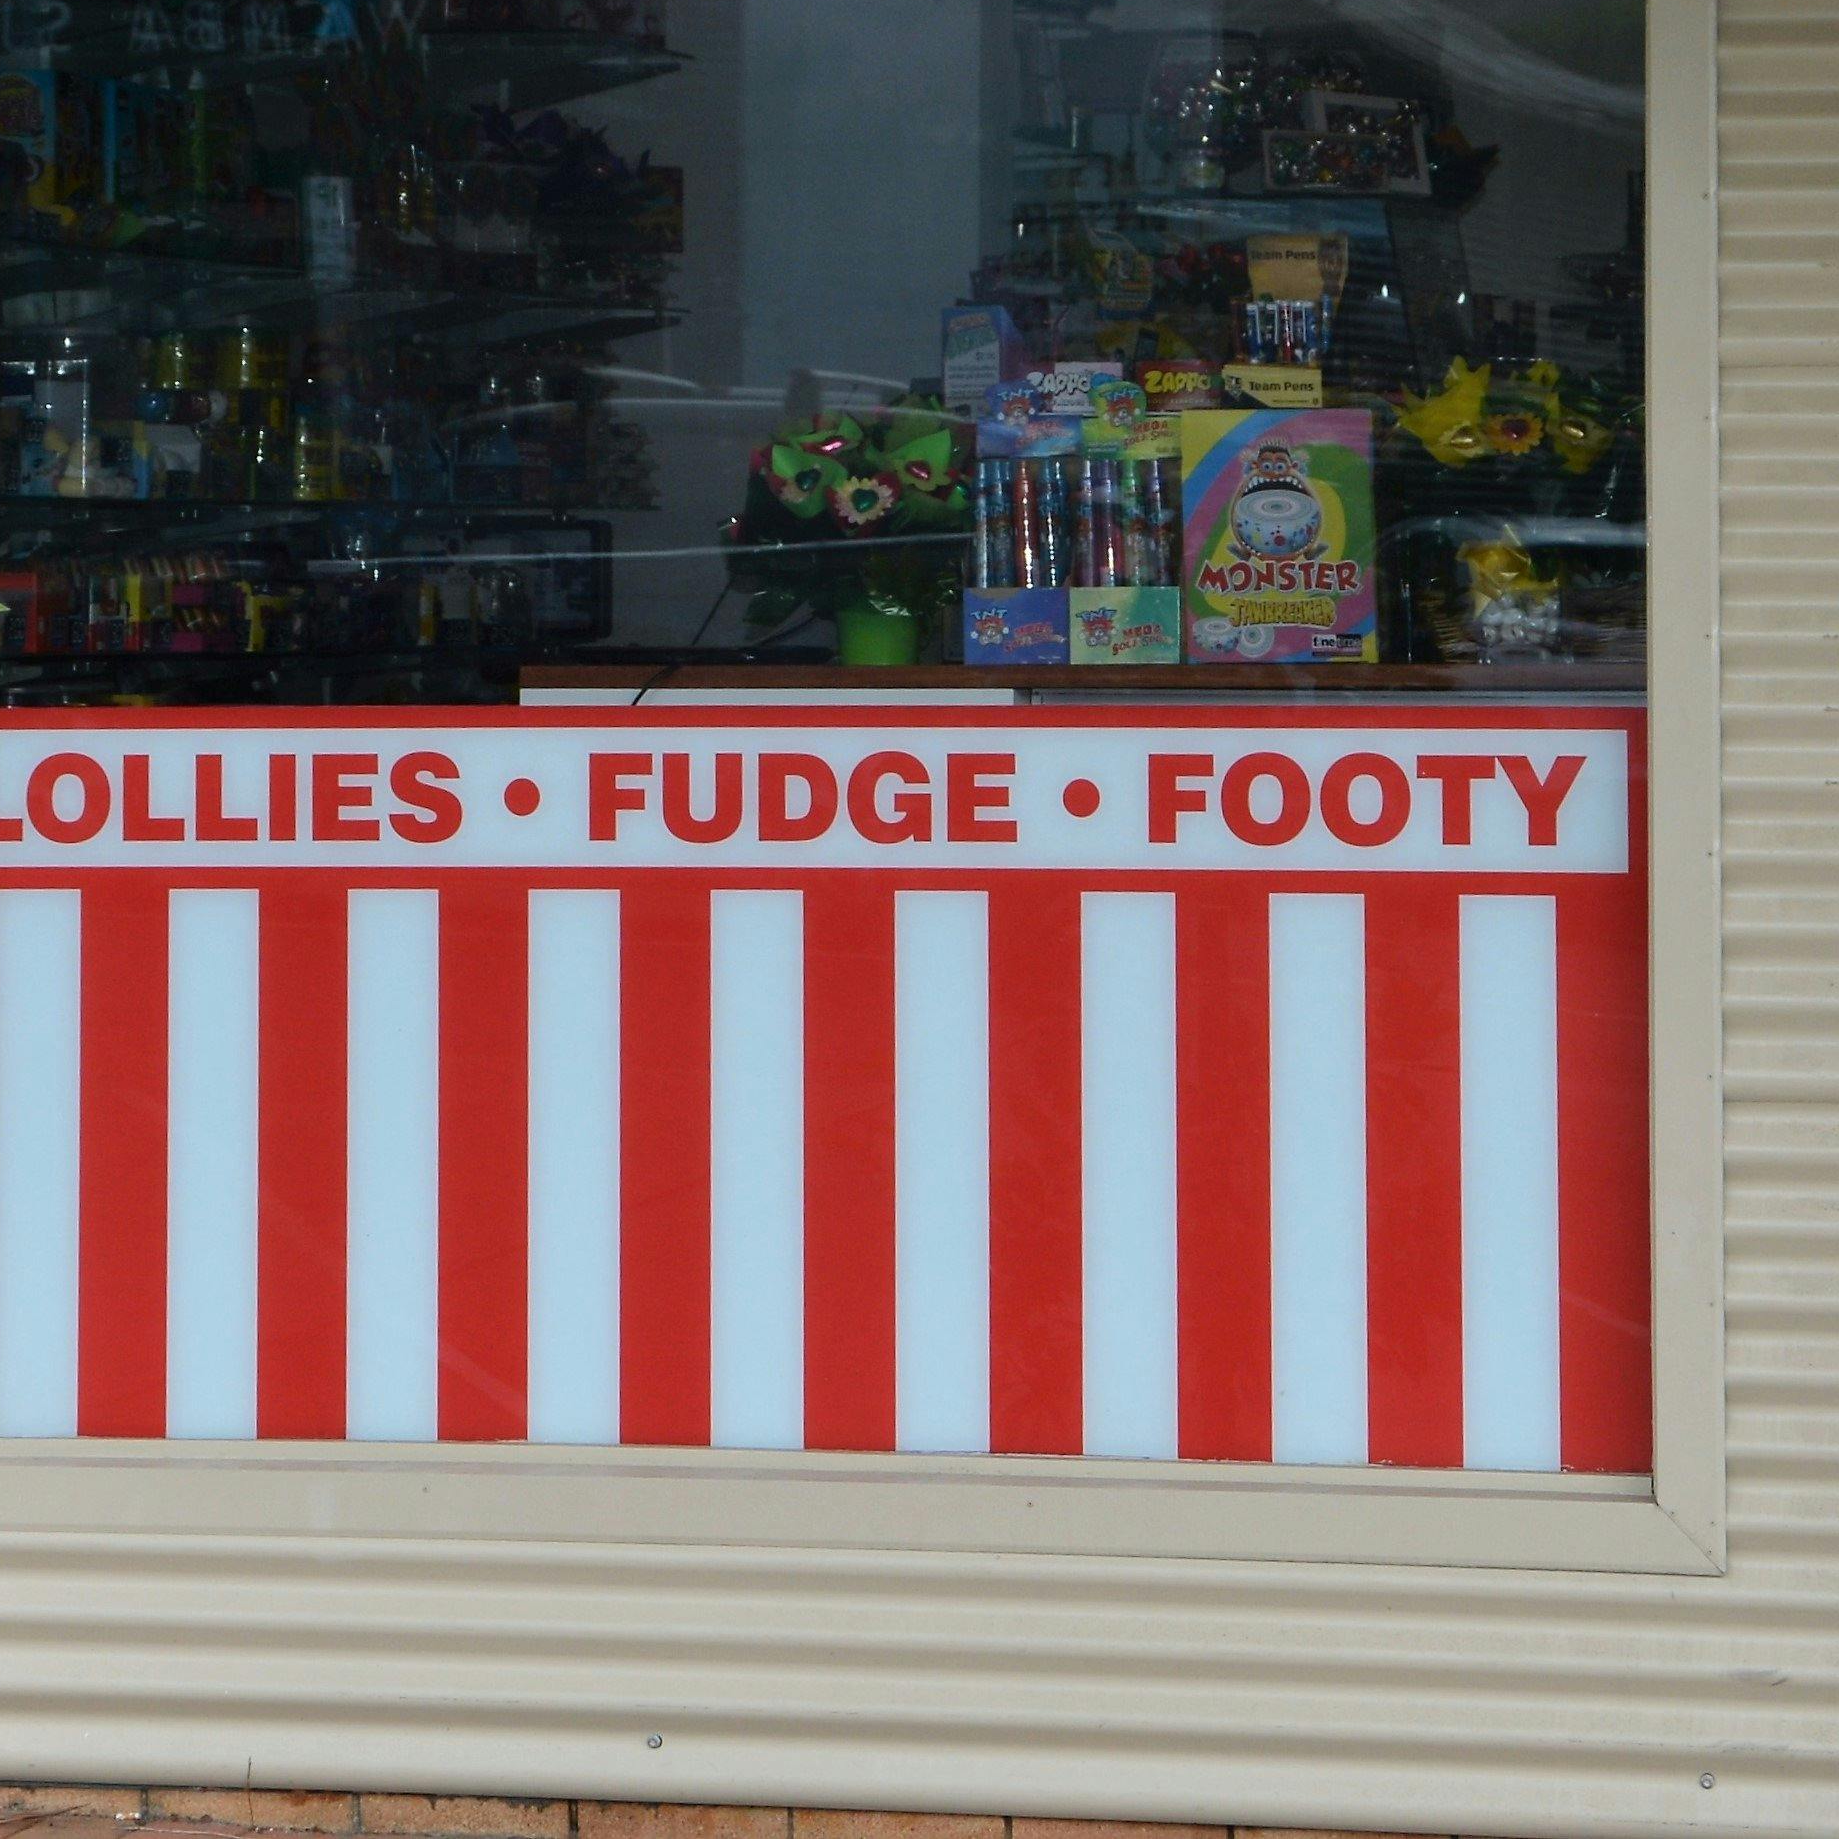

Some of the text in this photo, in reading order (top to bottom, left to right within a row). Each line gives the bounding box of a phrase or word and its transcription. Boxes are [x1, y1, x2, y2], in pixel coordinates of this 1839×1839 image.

[1285, 250, 1316, 261] Pens
[1144, 370, 1211, 394] ZAPPO
[1249, 381, 1280, 392] Team
[1284, 381, 1315, 392] Pens
[1197, 561, 1360, 593] MONSTER
[971, 608, 1008, 620] TNT
[1078, 607, 1117, 621] TNT
[589, 751, 1018, 844] FUDGE
[1148, 752, 1587, 847] FOOTY
